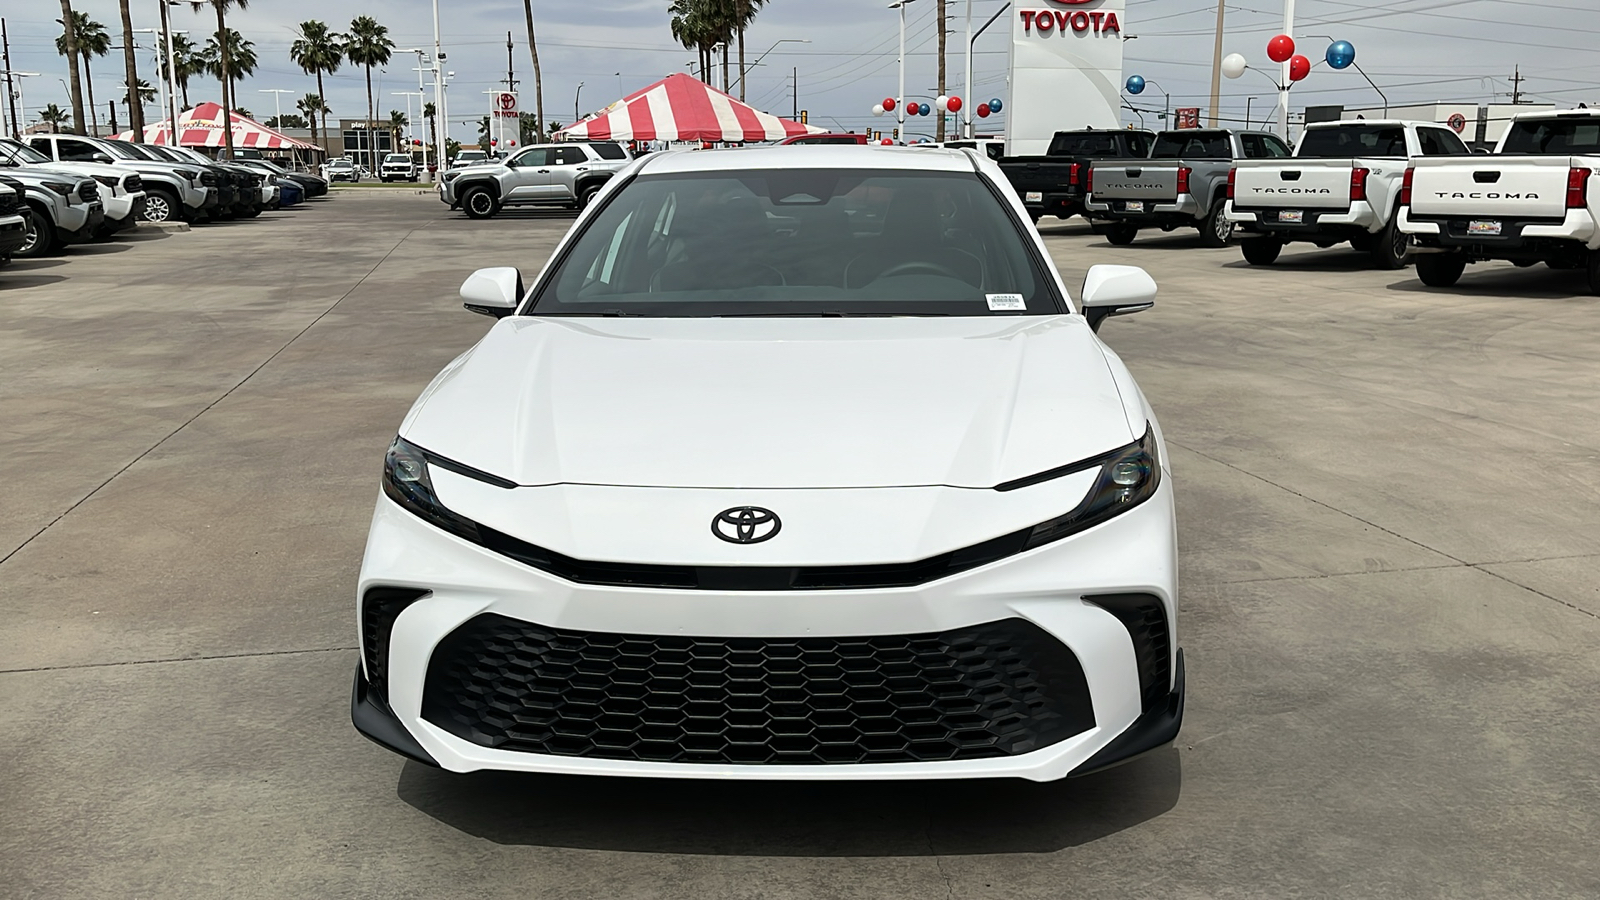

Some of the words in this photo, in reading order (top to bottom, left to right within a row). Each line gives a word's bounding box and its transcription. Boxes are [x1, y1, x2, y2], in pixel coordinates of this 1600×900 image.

[1020, 10, 1120, 32] TOYOTA
[493, 110, 519, 118] TOYOTA
[351, 121, 366, 129] play
